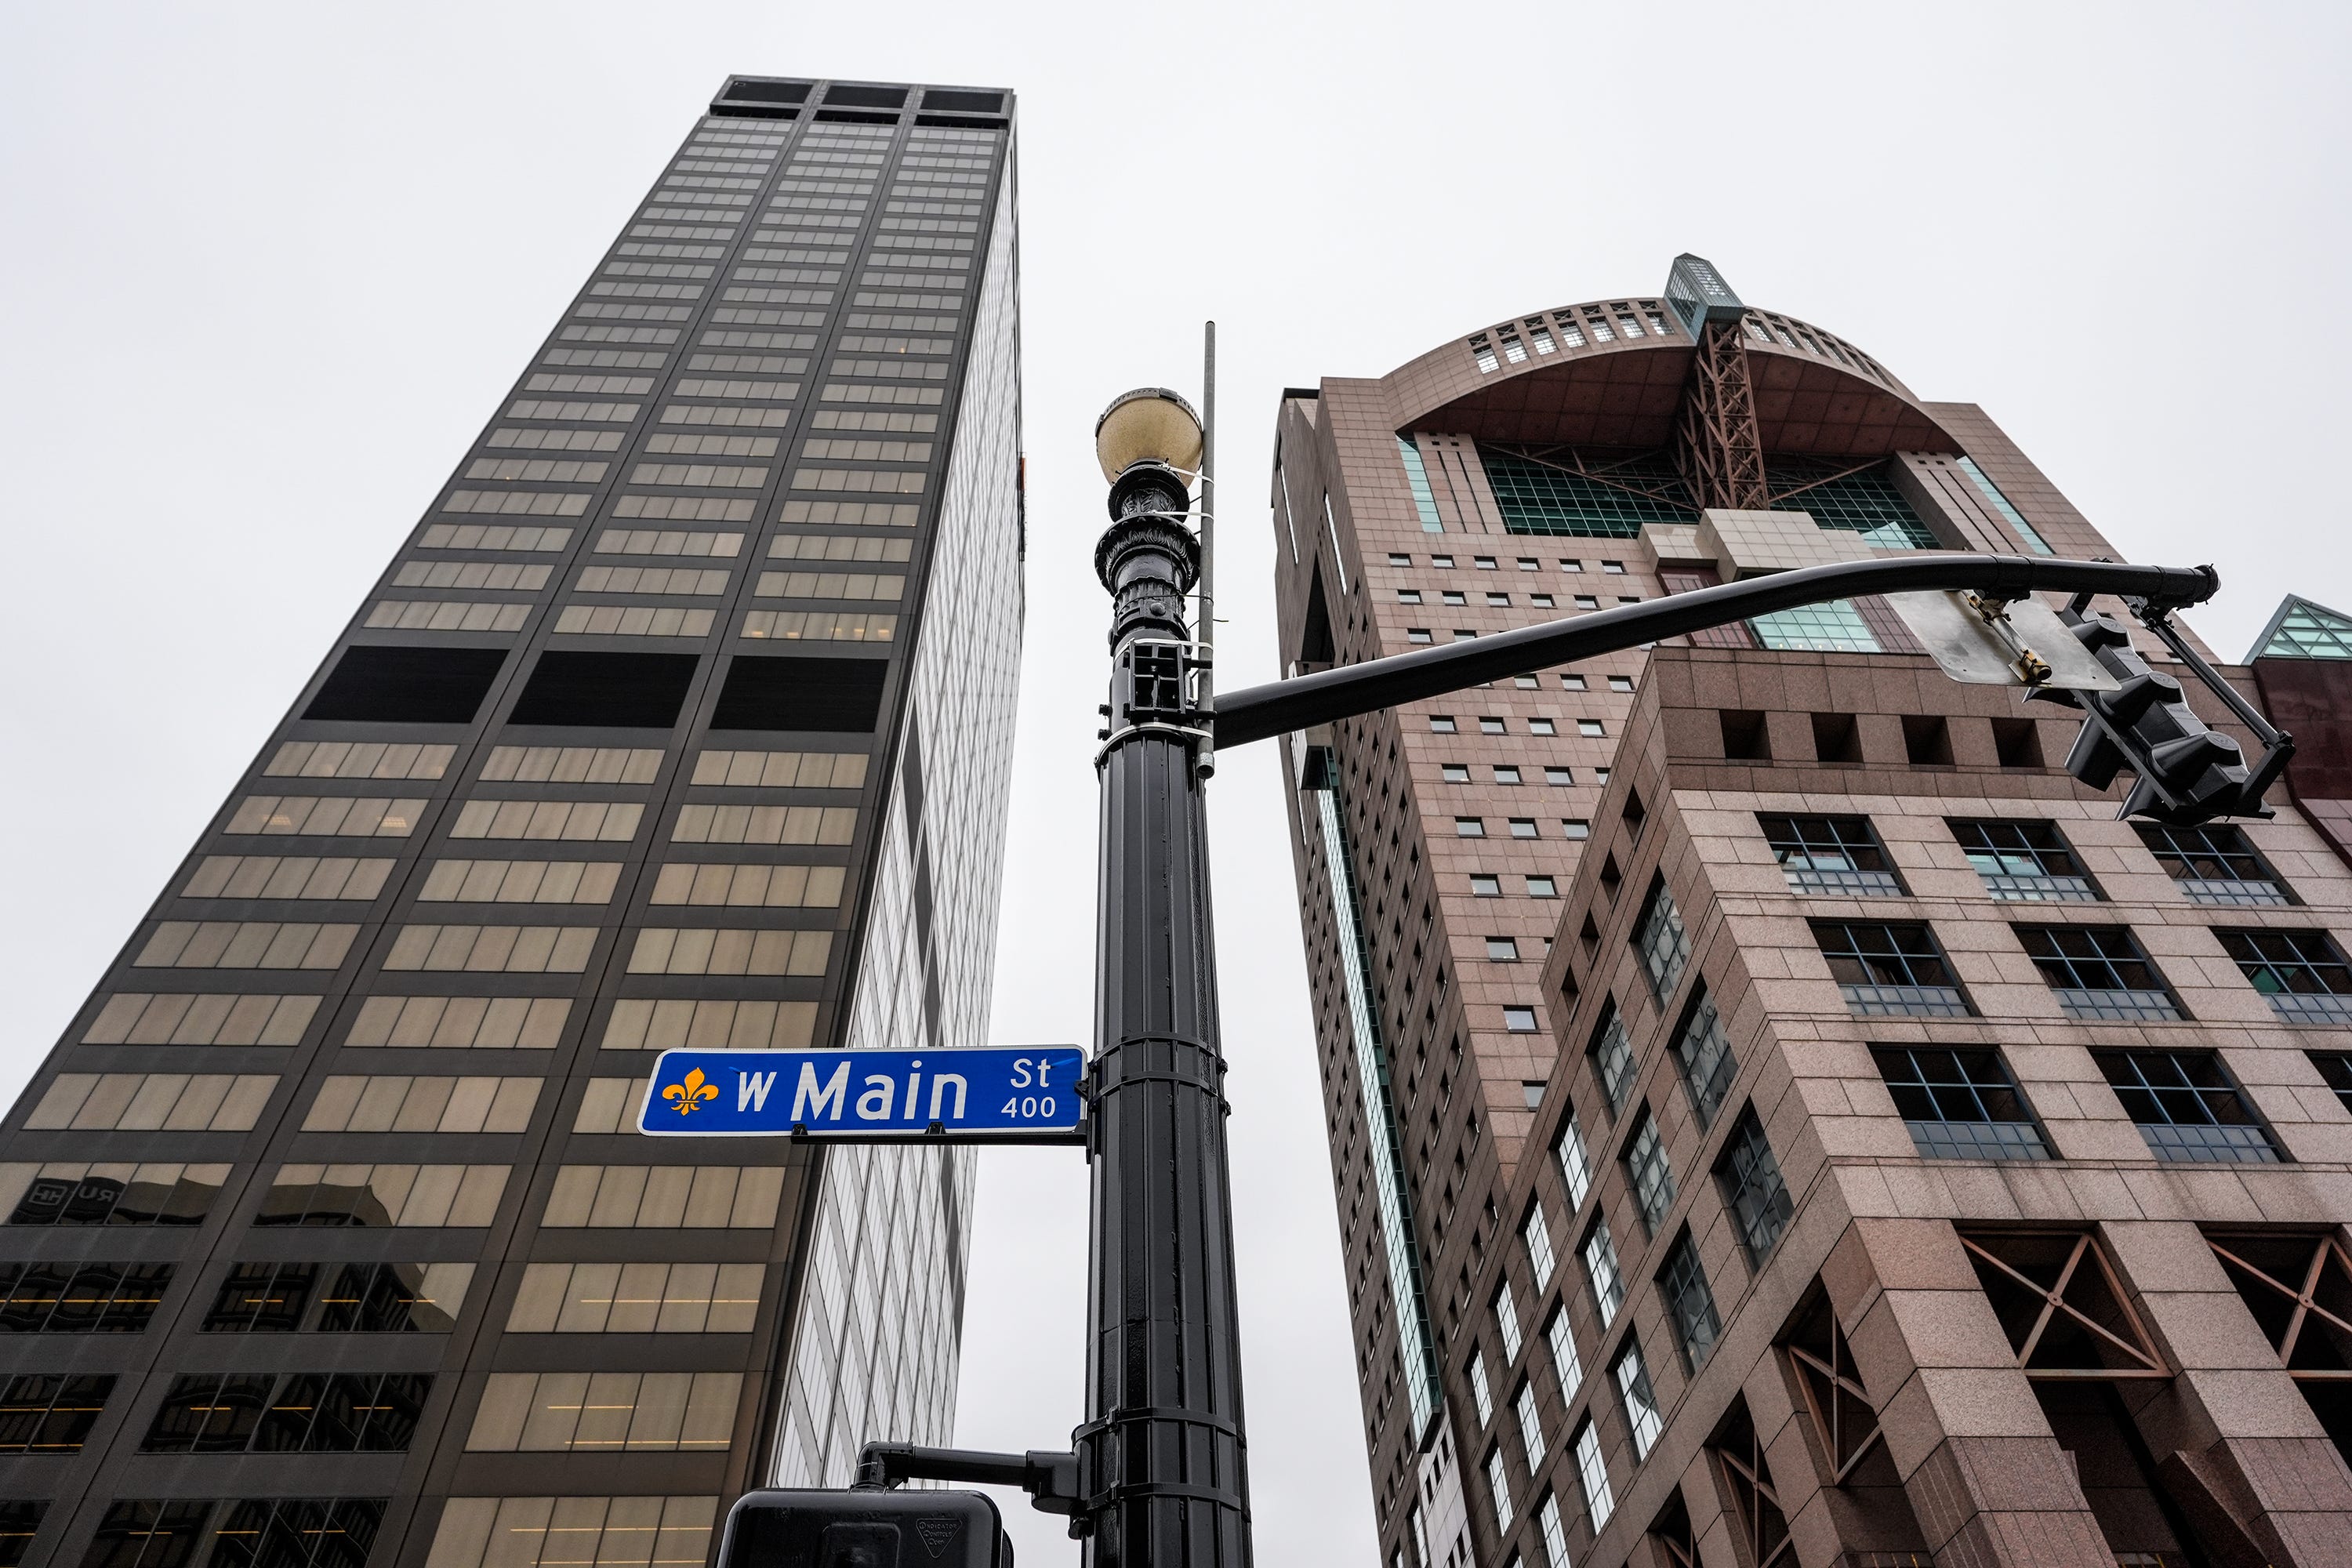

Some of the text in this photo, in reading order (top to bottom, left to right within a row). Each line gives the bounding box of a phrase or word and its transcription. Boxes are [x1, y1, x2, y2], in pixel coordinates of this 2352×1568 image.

[737, 1058, 1051, 1121] W Main St
[1000, 1096, 1056, 1119] 400
